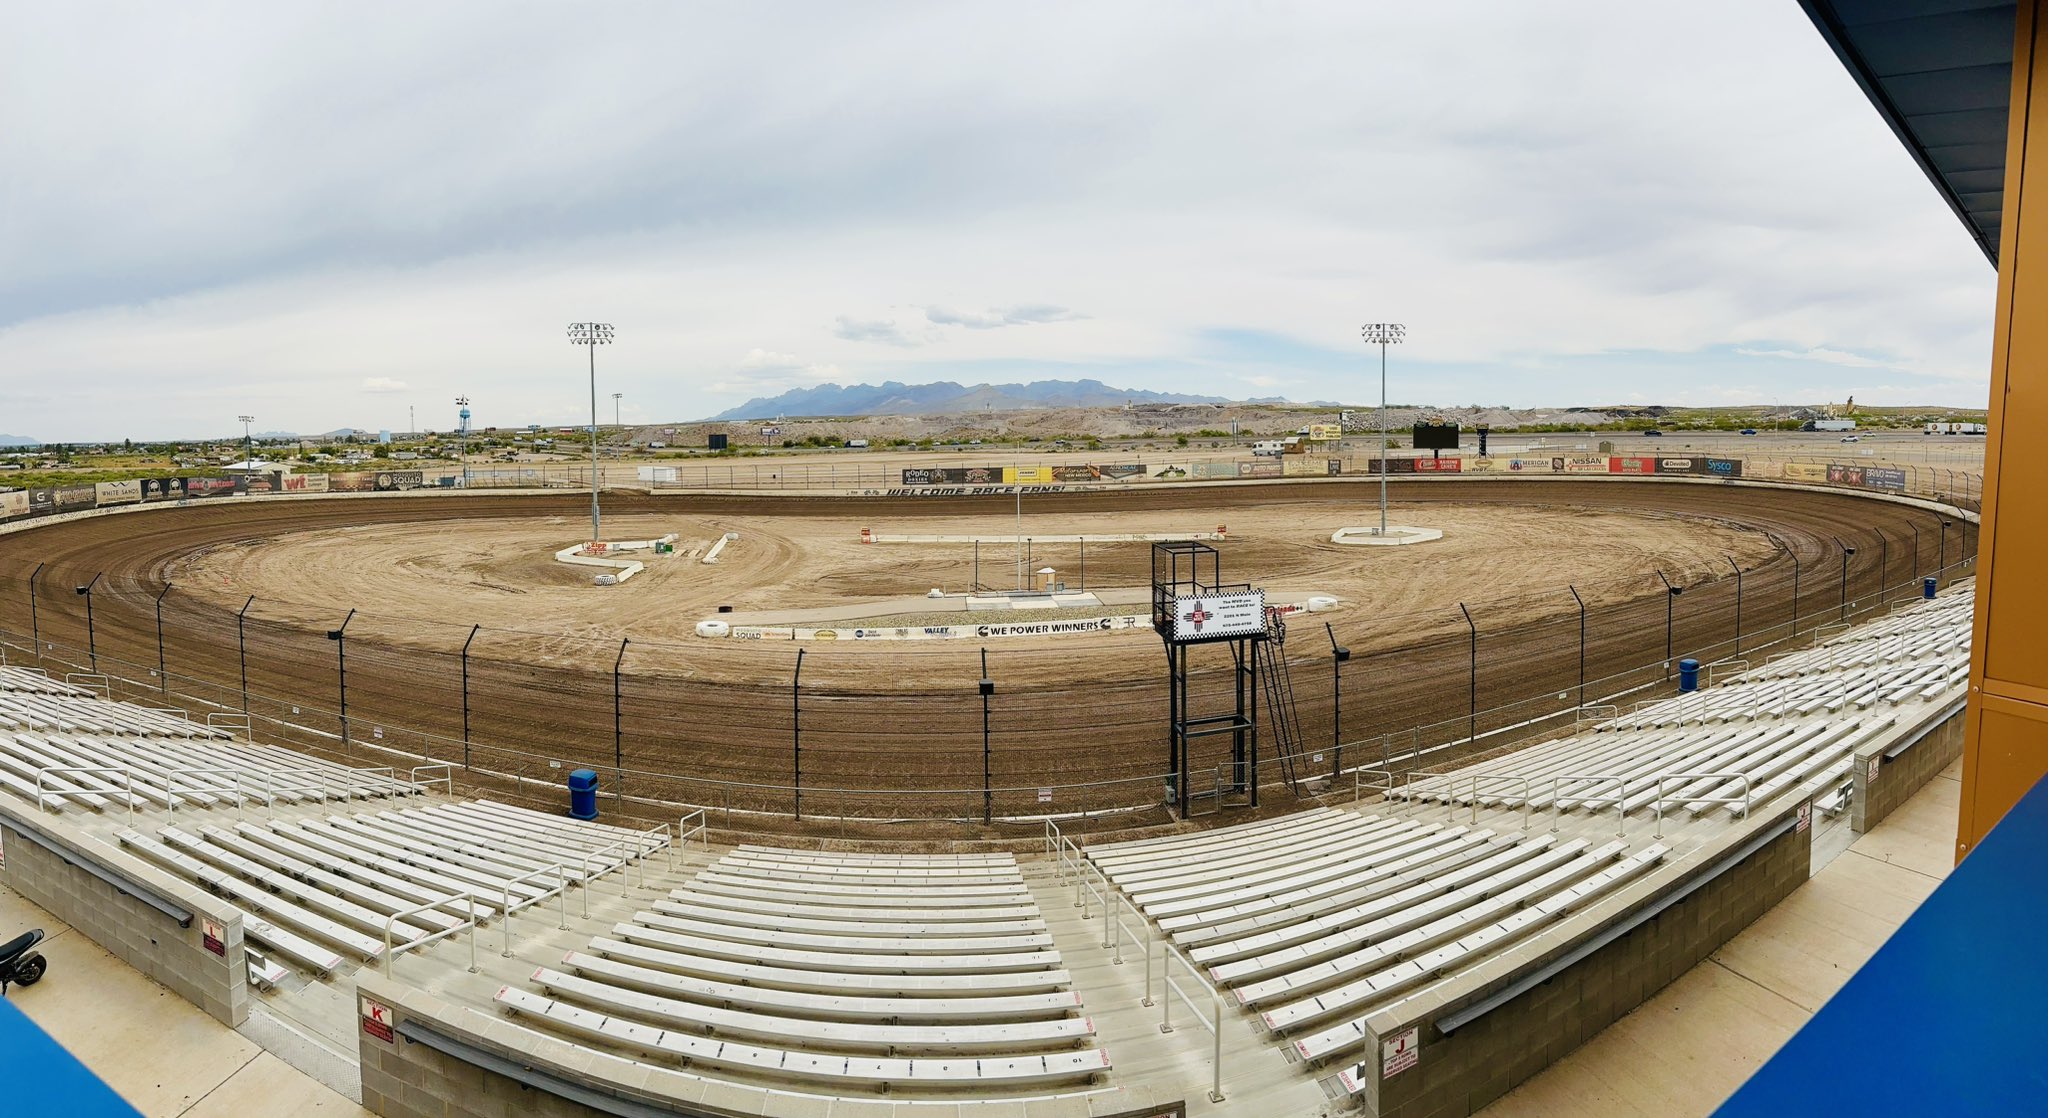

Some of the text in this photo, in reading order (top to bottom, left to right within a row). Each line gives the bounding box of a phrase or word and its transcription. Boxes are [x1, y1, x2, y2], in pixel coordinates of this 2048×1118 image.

[1707, 459, 1732, 471] Sysco
[393, 476, 421, 484] SQUAD
[887, 487, 966, 496] WELCOME
[990, 621, 1099, 635] WE POWER WINNERS
[210, 926, 217, 939] L
[372, 1006, 384, 1023] K
[1388, 1029, 1413, 1046] SECTION
[1395, 1038, 1405, 1055] J
